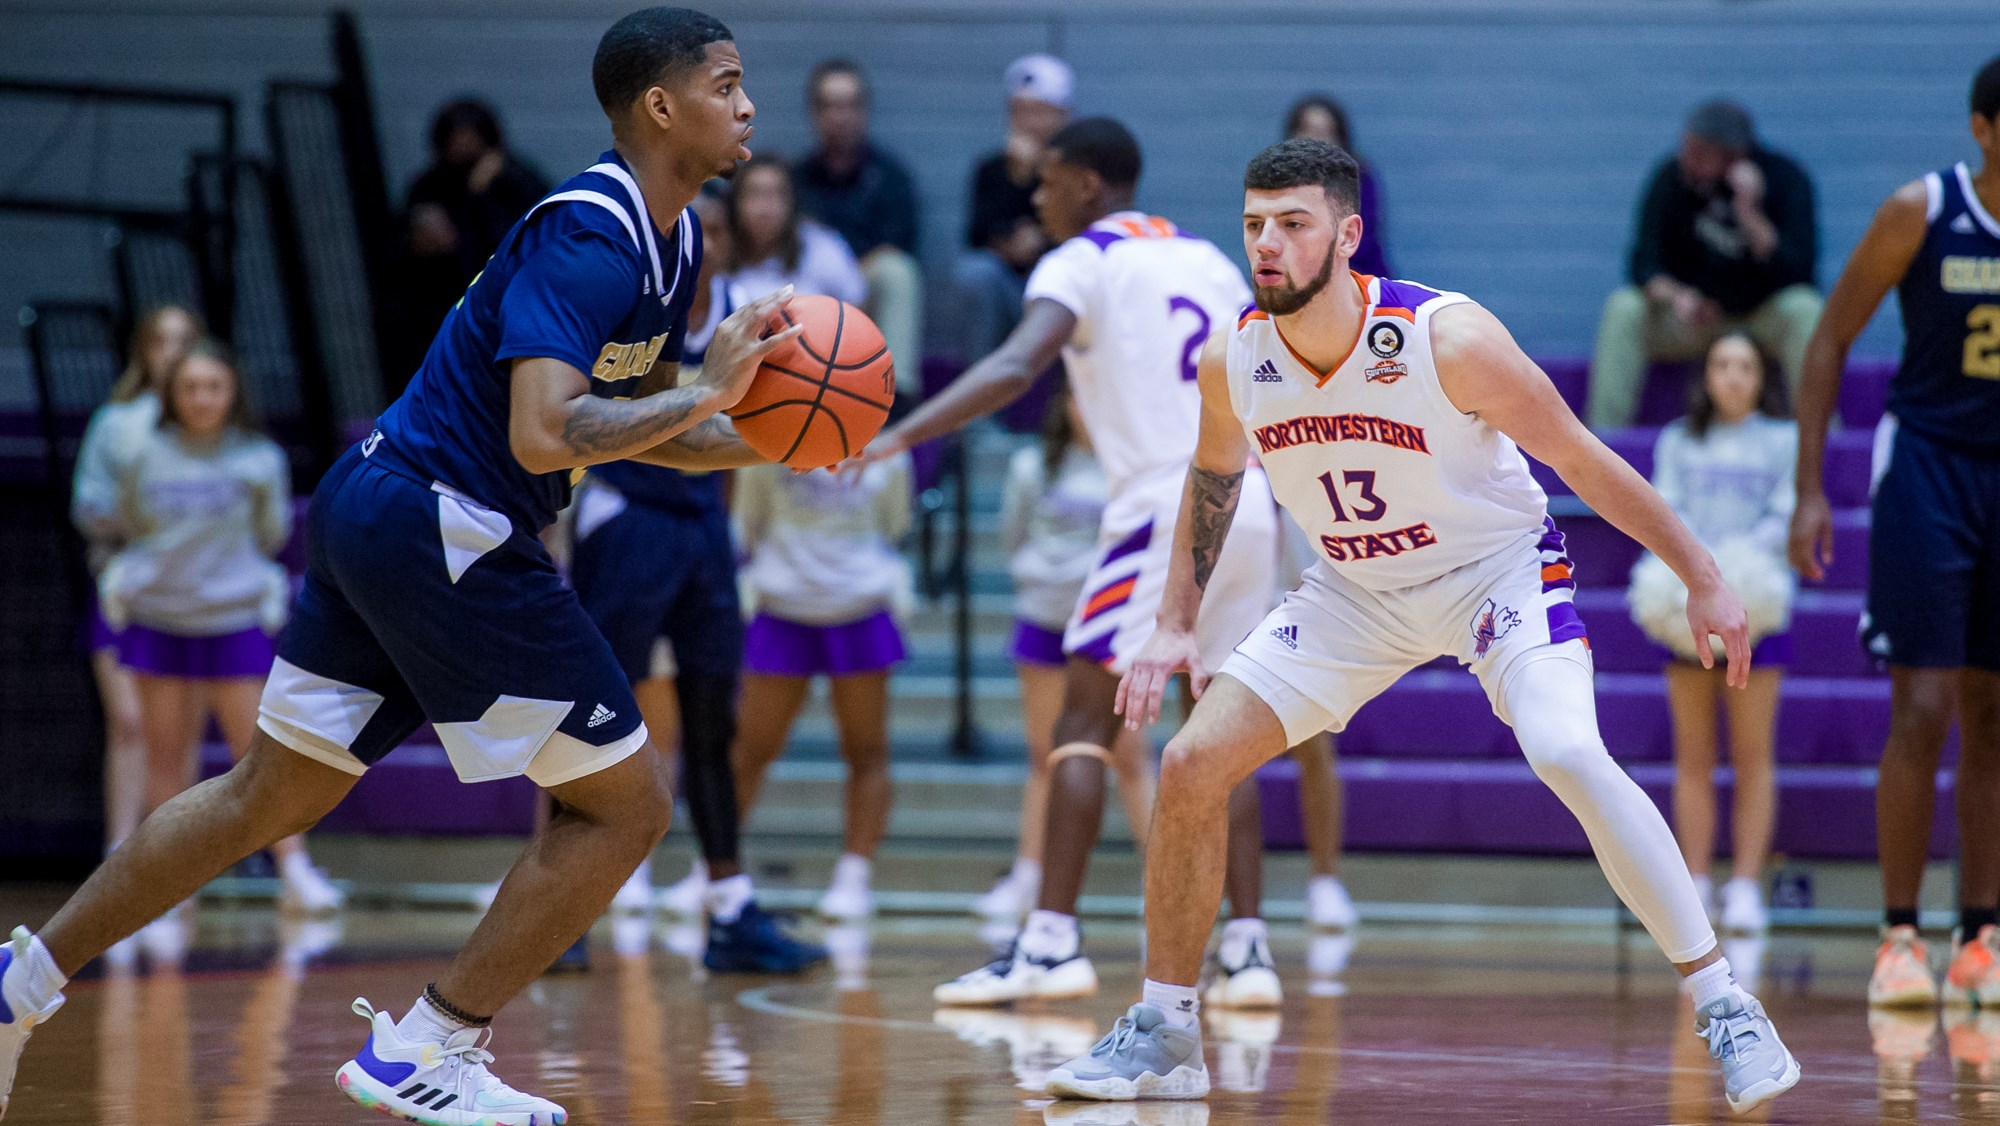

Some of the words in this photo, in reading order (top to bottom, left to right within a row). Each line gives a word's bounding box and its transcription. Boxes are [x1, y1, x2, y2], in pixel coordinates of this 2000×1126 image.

[1168, 296, 1210, 382] 2
[1252, 373, 1283, 383] adidas
[1253, 412, 1432, 456] NORTHWESTERN
[1317, 469, 1387, 523] 13
[1320, 521, 1438, 562] STATE
[1270, 628, 1298, 650] adidas
[587, 711, 617, 728] adidas
